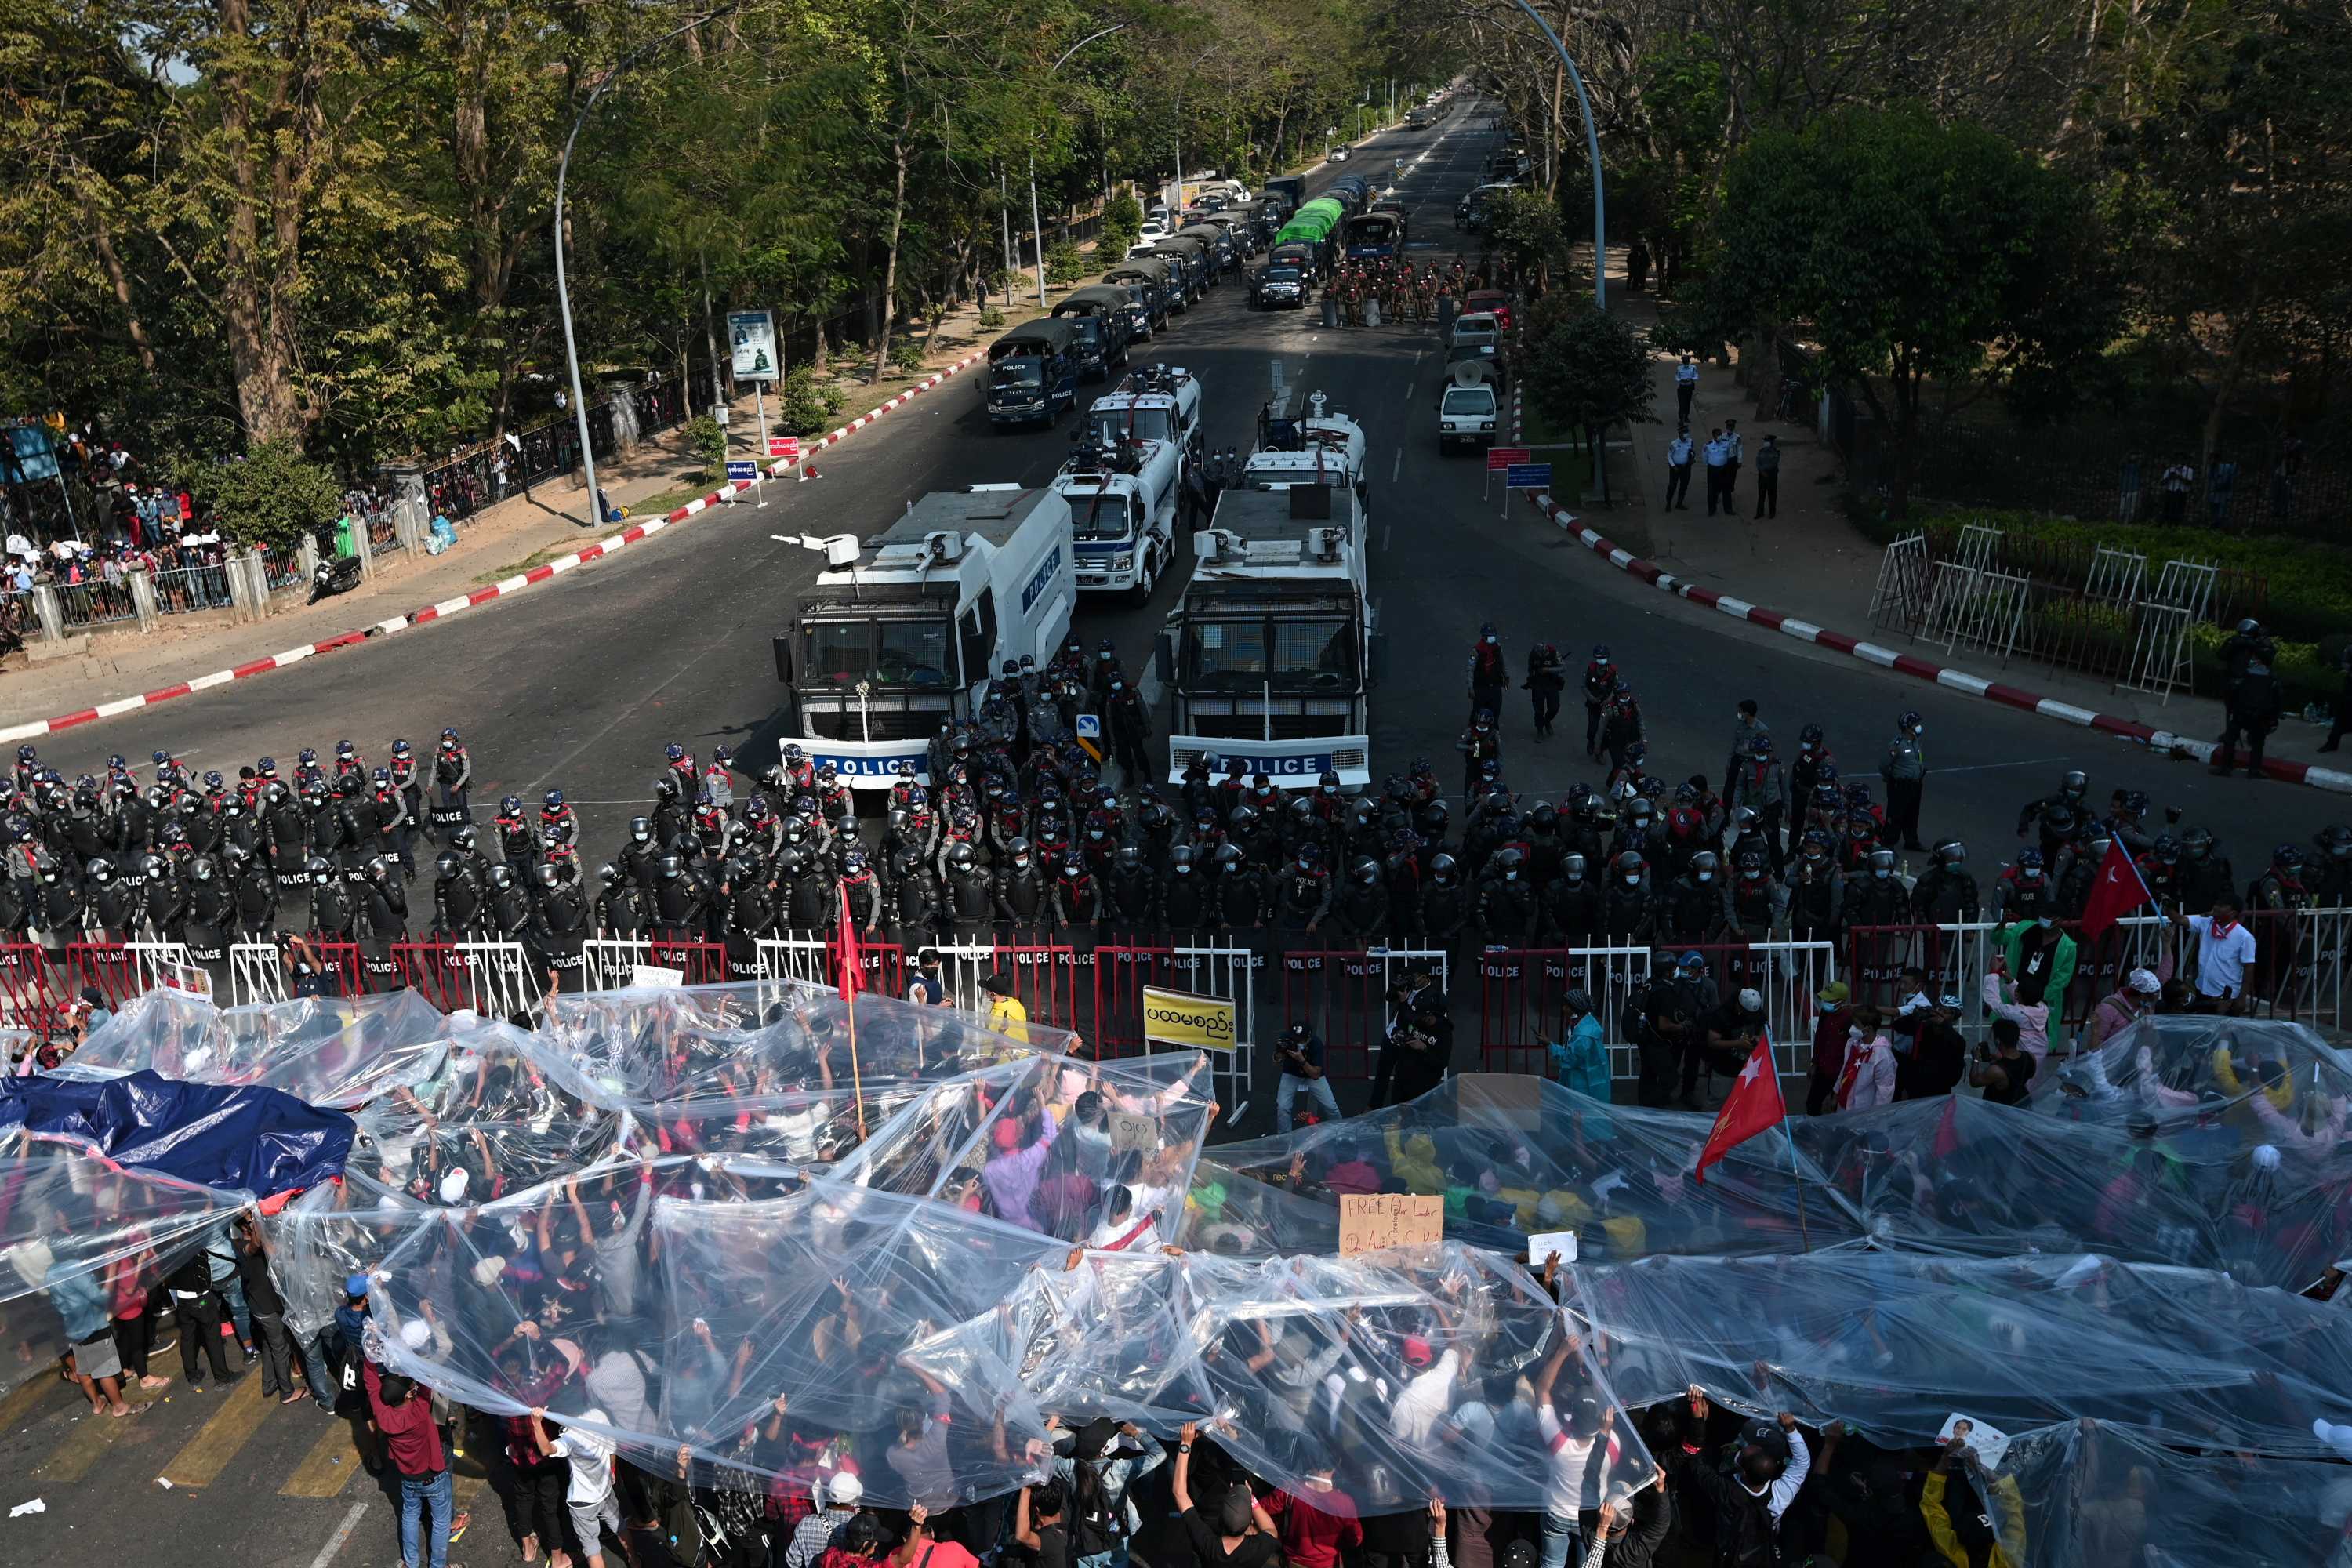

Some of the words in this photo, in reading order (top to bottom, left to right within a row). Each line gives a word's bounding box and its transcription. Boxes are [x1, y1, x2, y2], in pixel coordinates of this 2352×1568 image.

[1051, 390, 1073, 399] POLICE
[1029, 554, 1055, 603] POLICE
[826, 758, 916, 776] POLIC
[432, 810, 463, 822] POLICE
[277, 872, 311, 884] POLICE
[191, 949, 222, 960] POLICE
[550, 953, 584, 969] POLICE
[1287, 957, 1322, 970] OLCE
[1733, 960, 1774, 975] PLICE
[1147, 1008, 1234, 1040] ပထမစည်း
[1348, 1196, 1386, 1218] FREE
